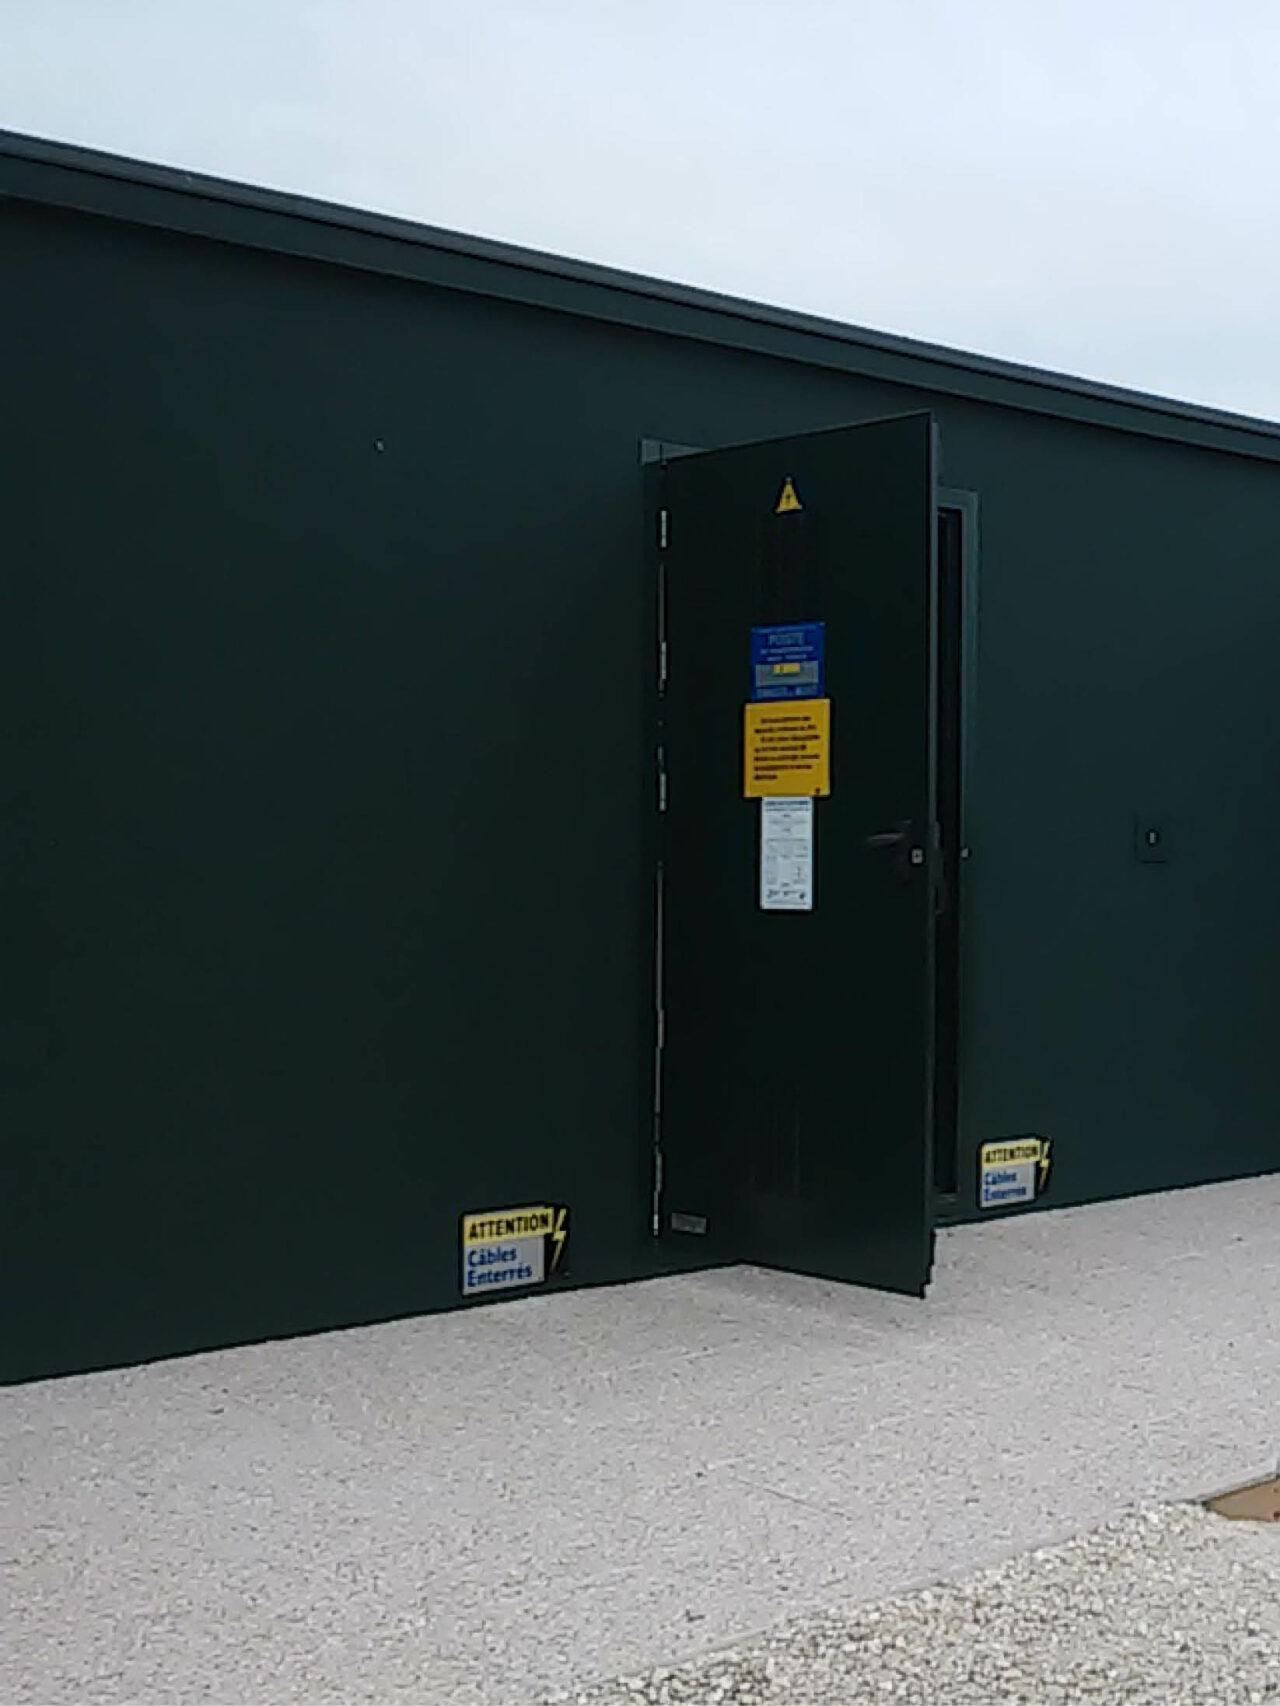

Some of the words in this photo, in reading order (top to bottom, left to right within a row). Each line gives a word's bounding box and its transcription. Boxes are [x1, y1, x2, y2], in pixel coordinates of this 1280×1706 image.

[983, 1145, 1038, 1163] ATTENTION
[468, 1212, 550, 1240] ATTENTION
[467, 1245, 517, 1267] Câbles
[467, 1262, 533, 1287] Enterrés
